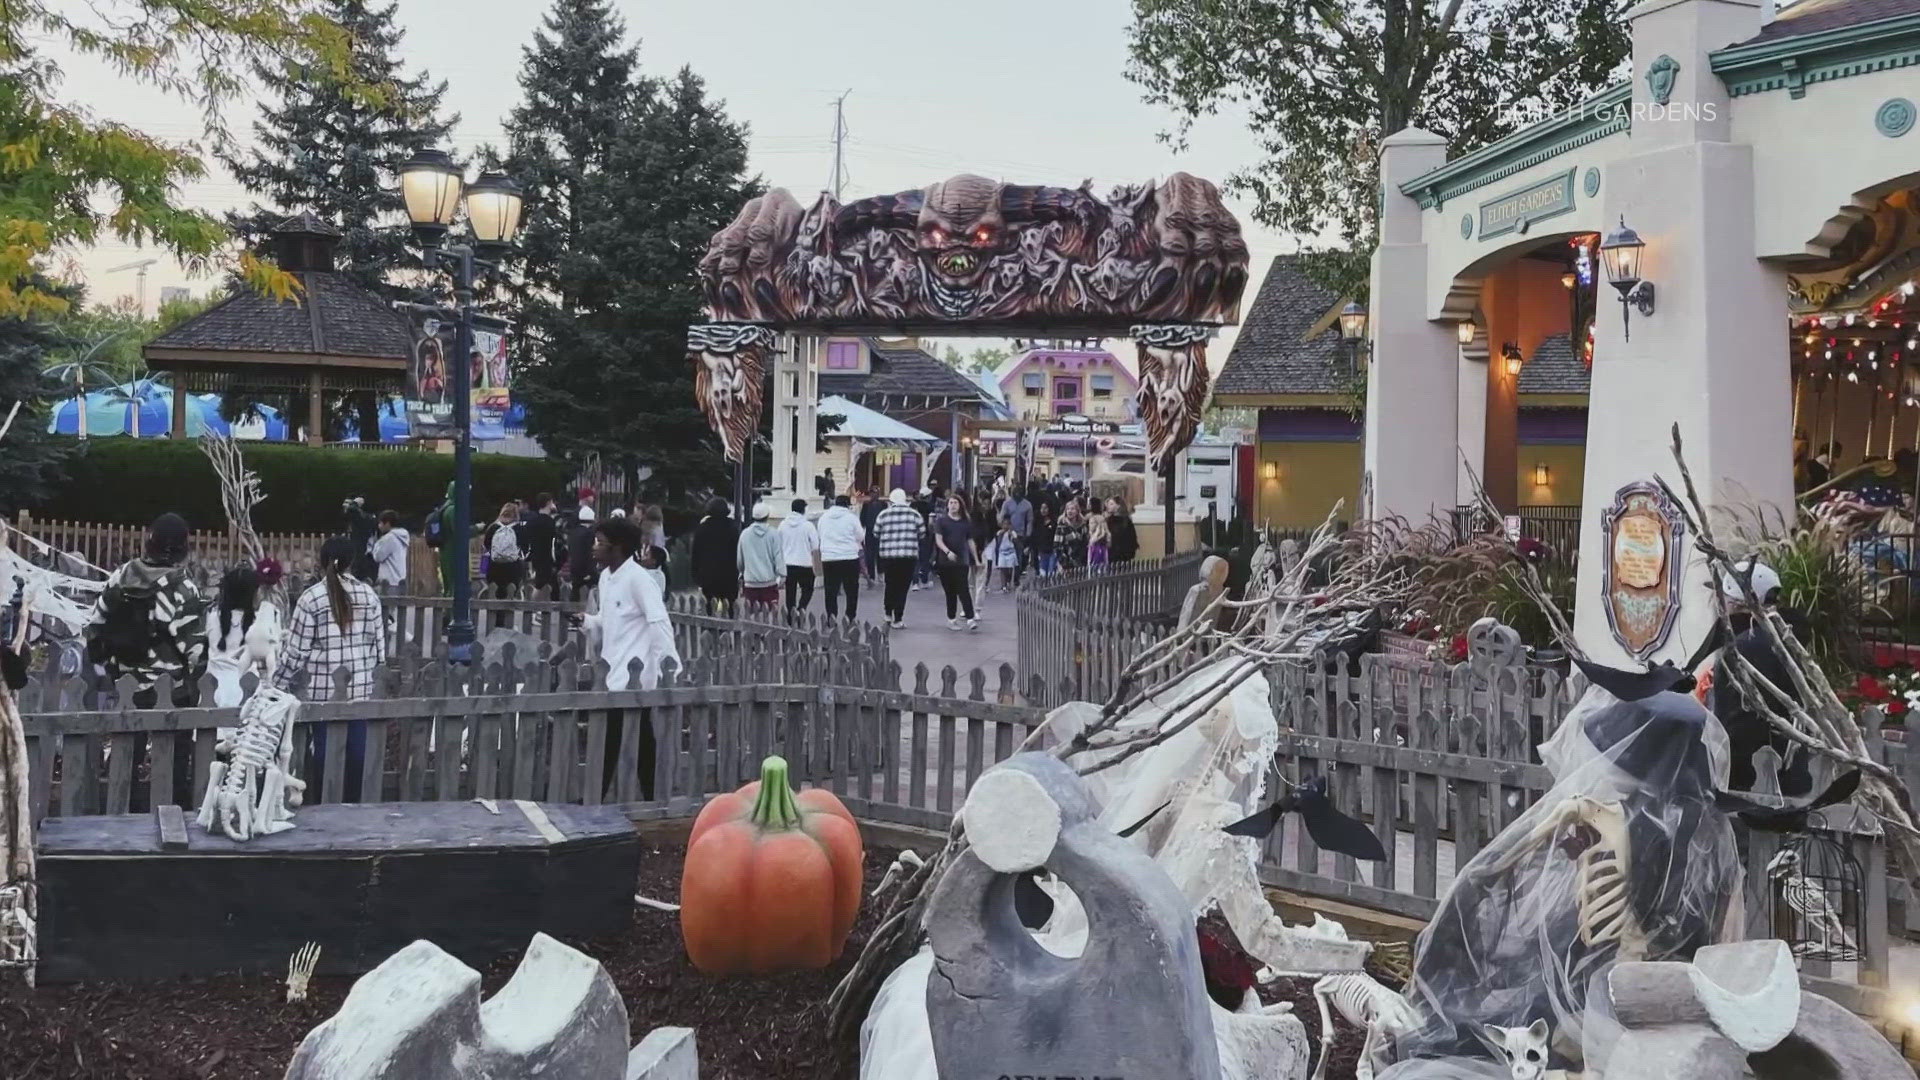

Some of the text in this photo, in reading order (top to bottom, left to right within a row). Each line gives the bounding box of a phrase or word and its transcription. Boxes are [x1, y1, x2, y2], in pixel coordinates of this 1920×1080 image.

[1487, 184, 1562, 225] ELITCH GARDENS
[432, 403, 453, 415] TREAT
